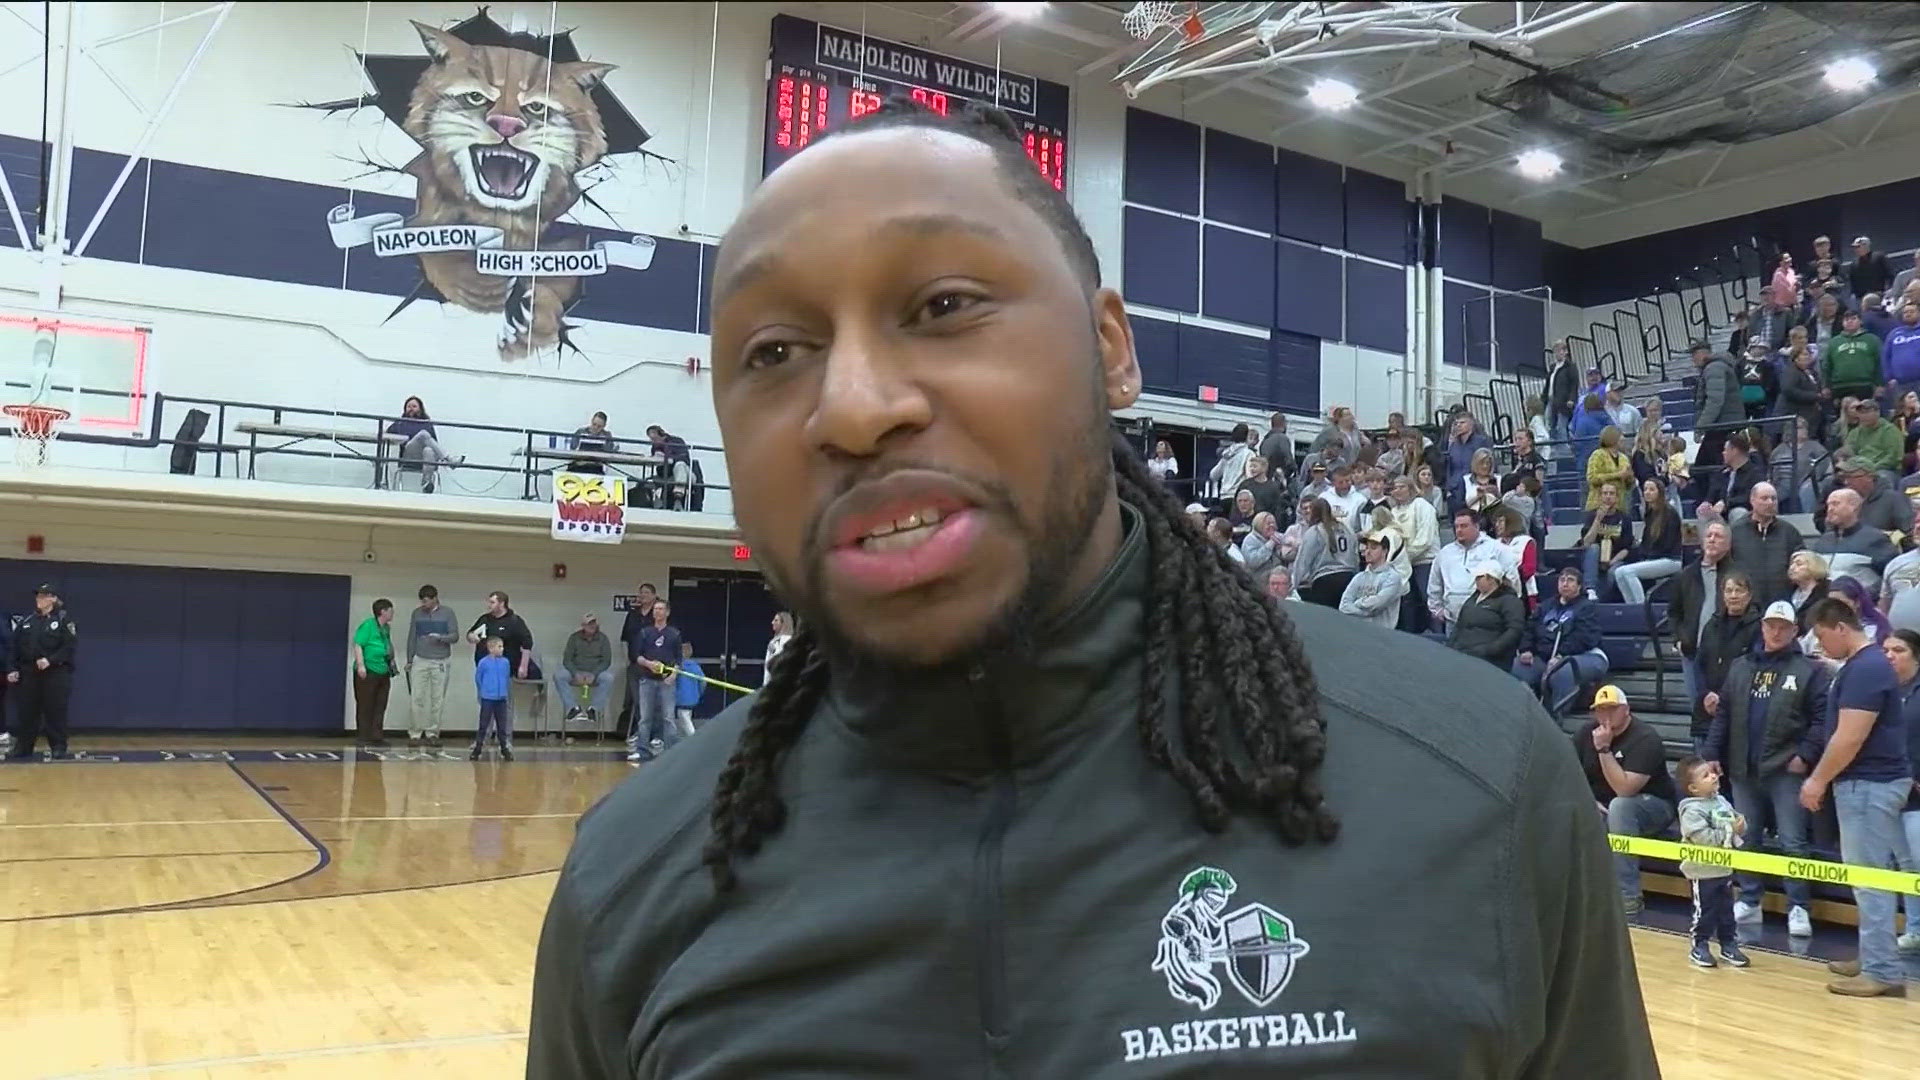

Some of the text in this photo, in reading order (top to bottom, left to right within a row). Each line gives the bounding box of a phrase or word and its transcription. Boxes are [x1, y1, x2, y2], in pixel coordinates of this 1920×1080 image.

[823, 34, 1031, 105] NAPOLEON WILDCATS
[852, 76, 877, 92] Home
[377, 229, 477, 251] NAPOLEON
[478, 252, 603, 272] HIGH SCHOOL
[556, 475, 625, 506] 96.1
[557, 521, 622, 534] SPORTS
[1121, 1010, 1357, 1062] BASKETBALL
